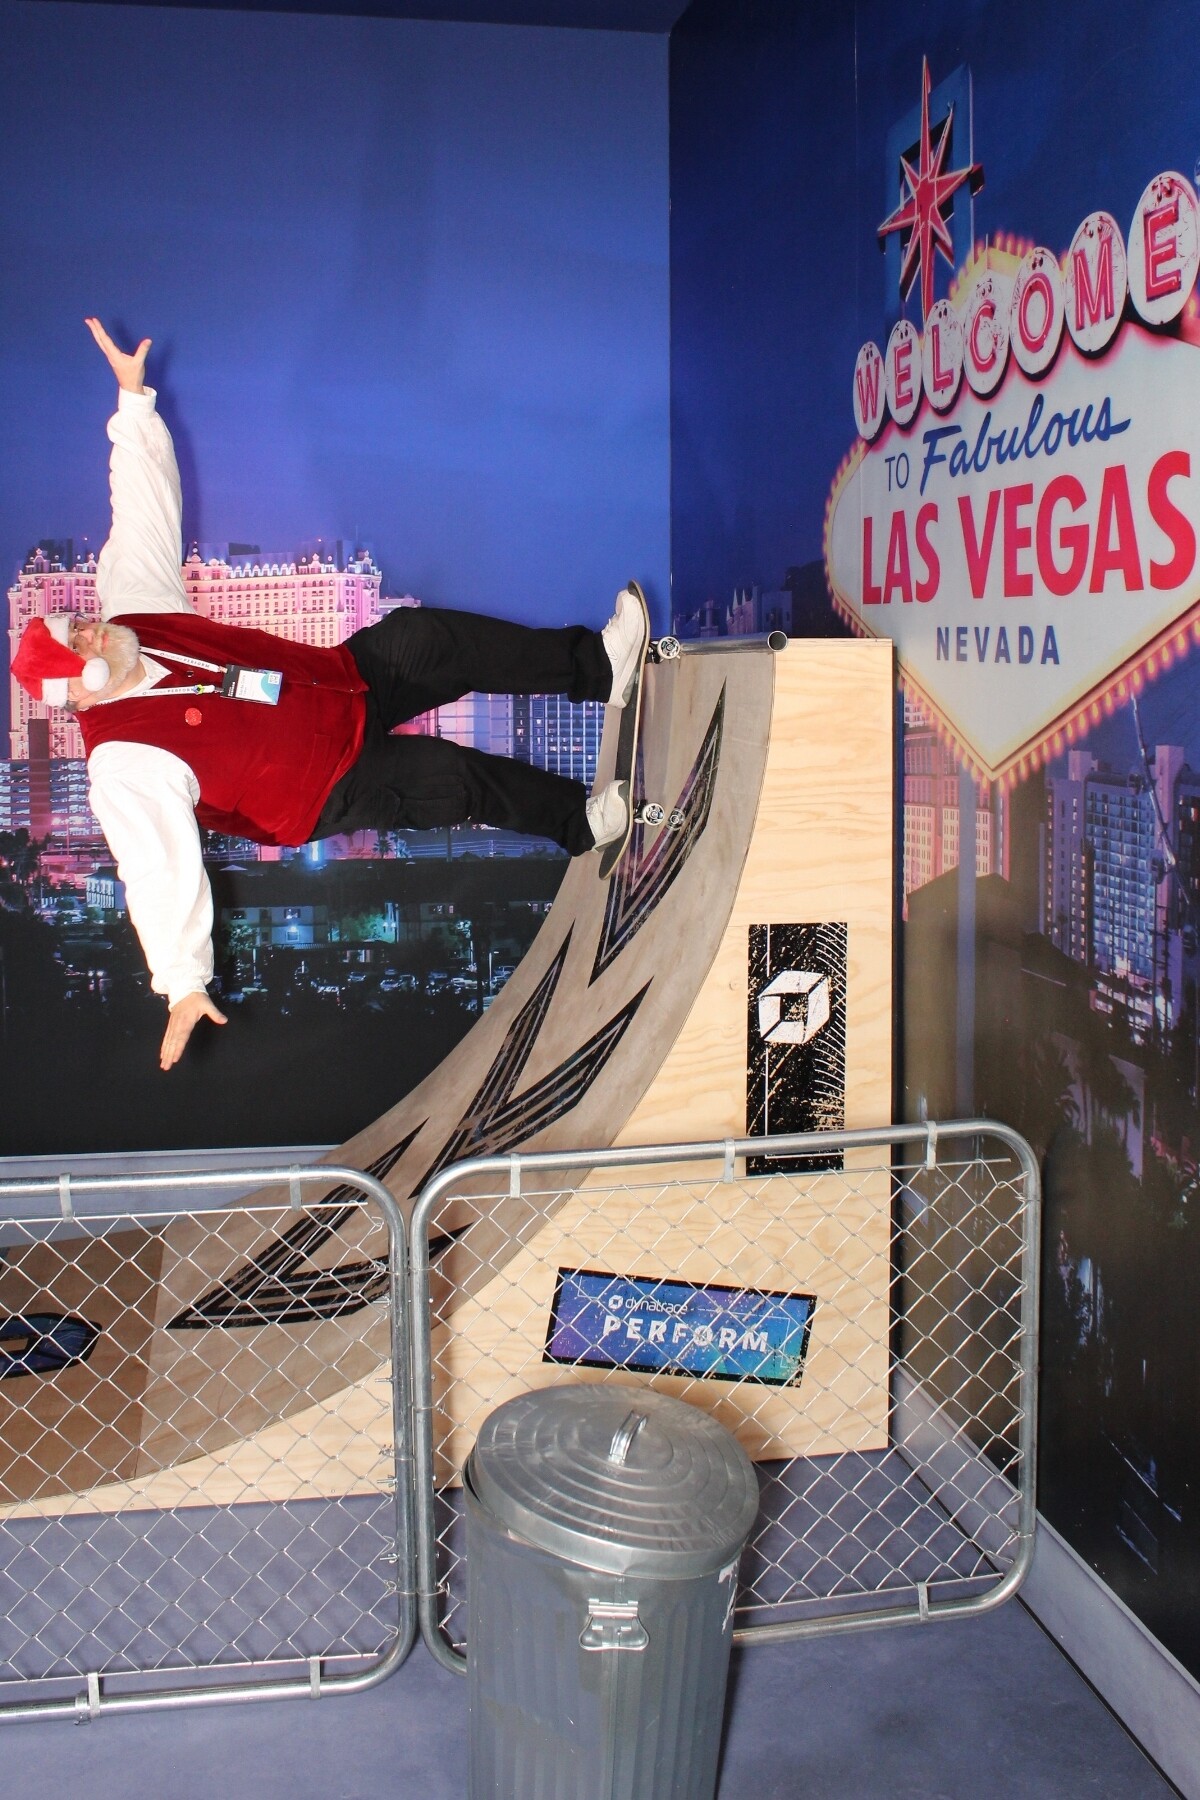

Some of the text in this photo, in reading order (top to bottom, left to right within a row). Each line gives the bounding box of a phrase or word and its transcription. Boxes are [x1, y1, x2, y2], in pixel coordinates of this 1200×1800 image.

[857, 204, 1181, 425] WELCOME
[885, 394, 1132, 496] TO Fabulous
[862, 451, 1197, 605] LAS VEGAS
[936, 624, 1060, 666] NEVADA
[602, 1314, 769, 1353] PERFORM
[625, 1297, 689, 1315] dynatrace
